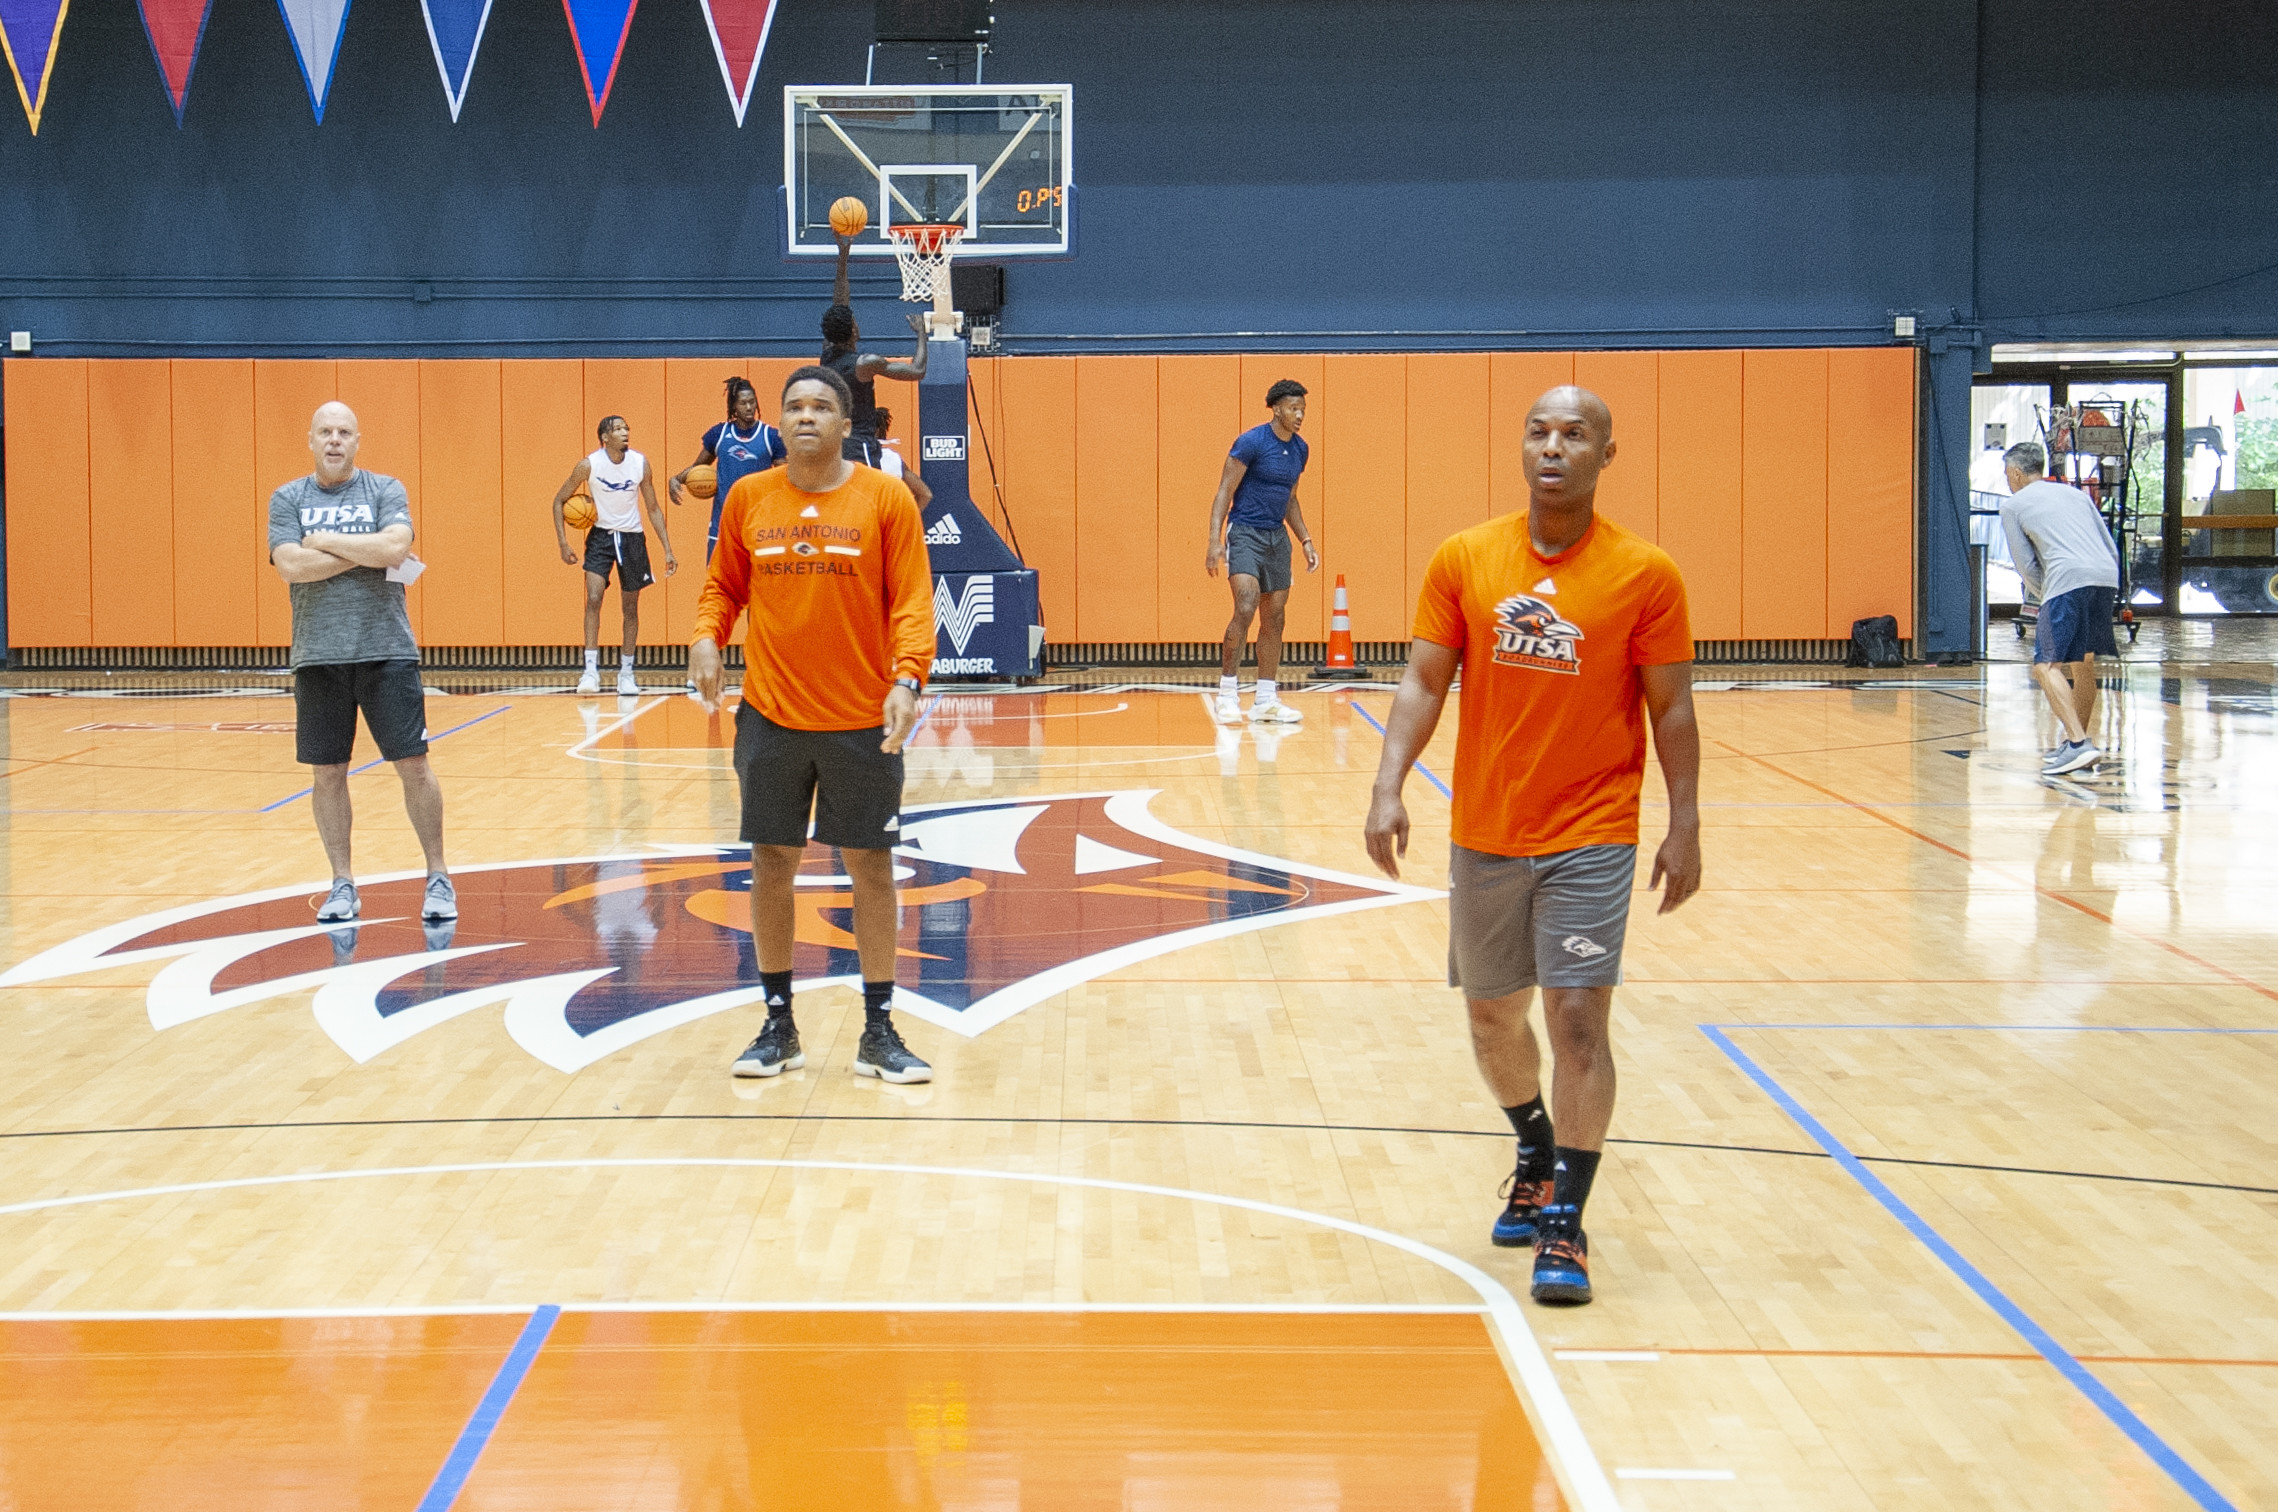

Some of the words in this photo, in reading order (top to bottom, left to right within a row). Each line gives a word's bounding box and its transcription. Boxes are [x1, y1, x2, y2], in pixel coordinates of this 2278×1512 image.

[930, 438, 958, 448] BUD
[926, 447, 963, 458] LIGHT
[300, 504, 374, 527] UTSA
[756, 526, 786, 543] SAN
[790, 524, 862, 542] ANTONIO
[1500, 632, 1574, 661] UTSA
[928, 657, 995, 675] ABURGER
